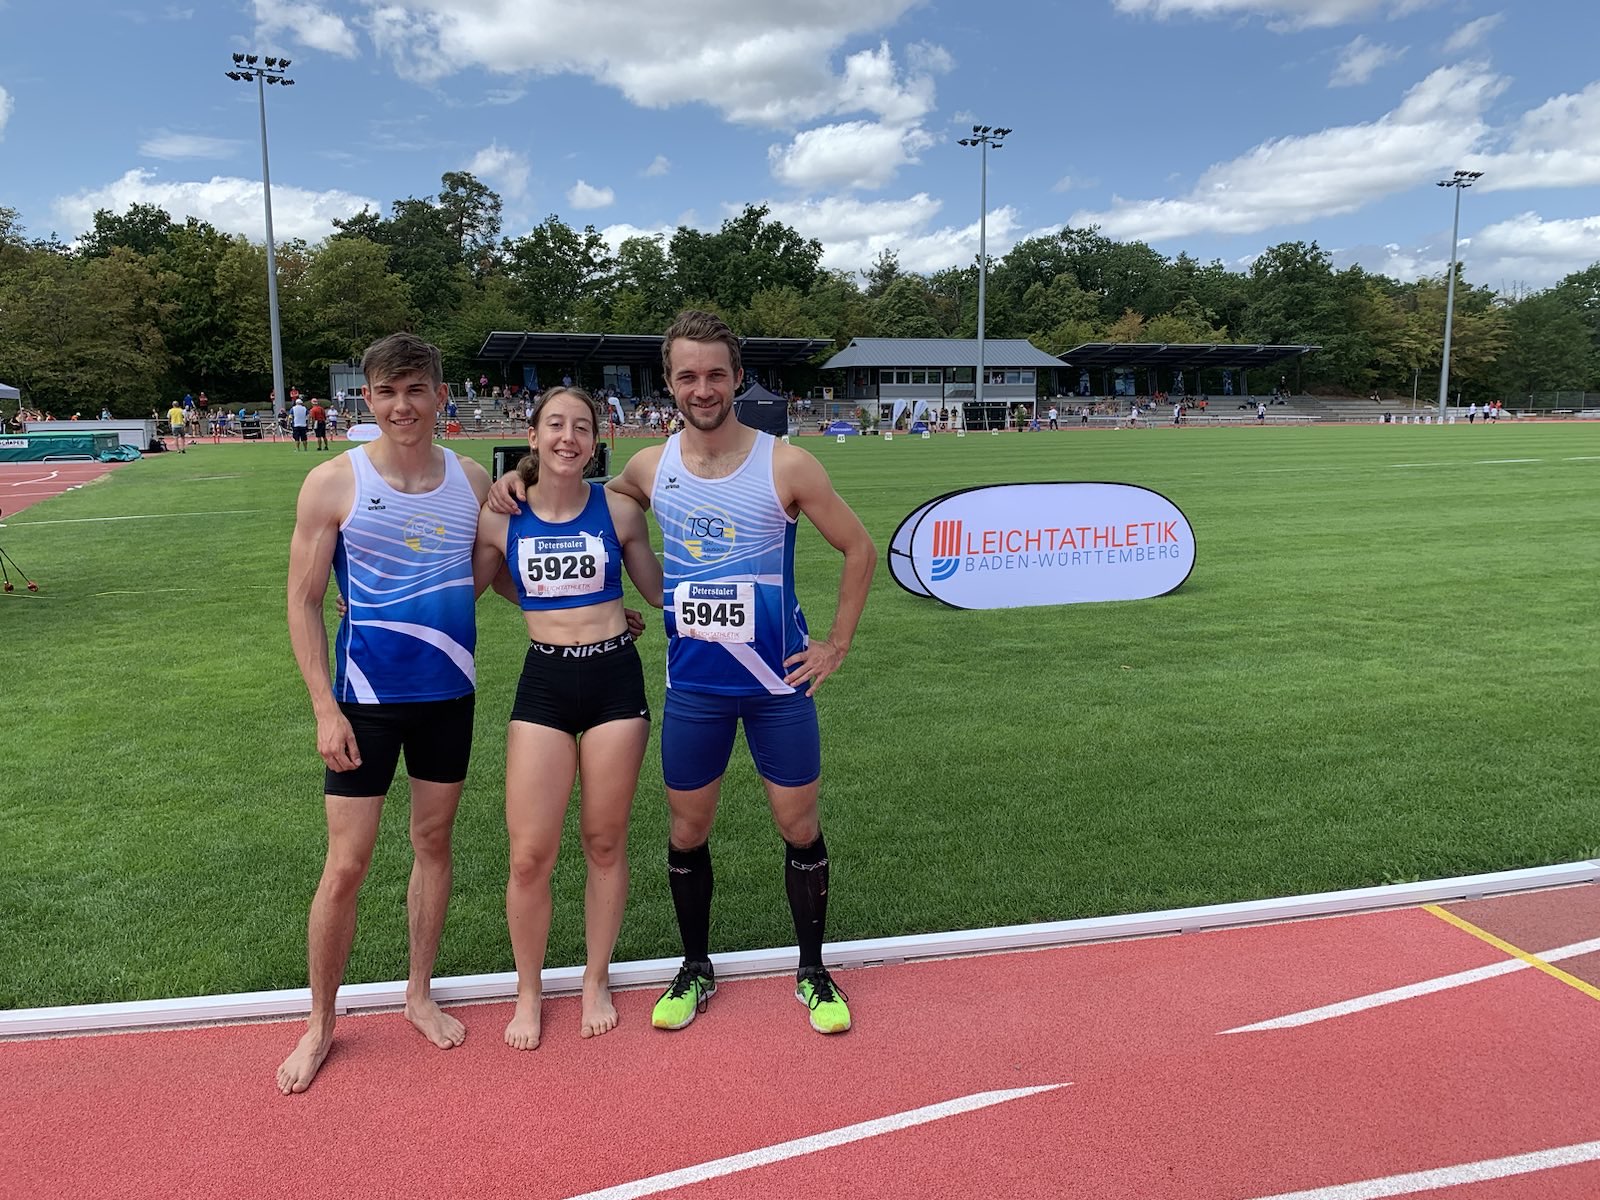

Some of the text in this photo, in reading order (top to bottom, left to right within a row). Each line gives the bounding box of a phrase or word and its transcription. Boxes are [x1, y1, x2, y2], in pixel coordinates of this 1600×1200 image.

[688, 517, 725, 538] TSG
[966, 520, 1178, 555] LEICHTATHLETIK
[538, 540, 583, 551] Peterstaler
[527, 554, 597, 582] 5928
[965, 544, 1180, 572] BADEN-WÜRTTEMBERG
[692, 585, 734, 596] Peterstaler
[682, 602, 745, 627] 5945
[562, 639, 618, 658] NIKE
